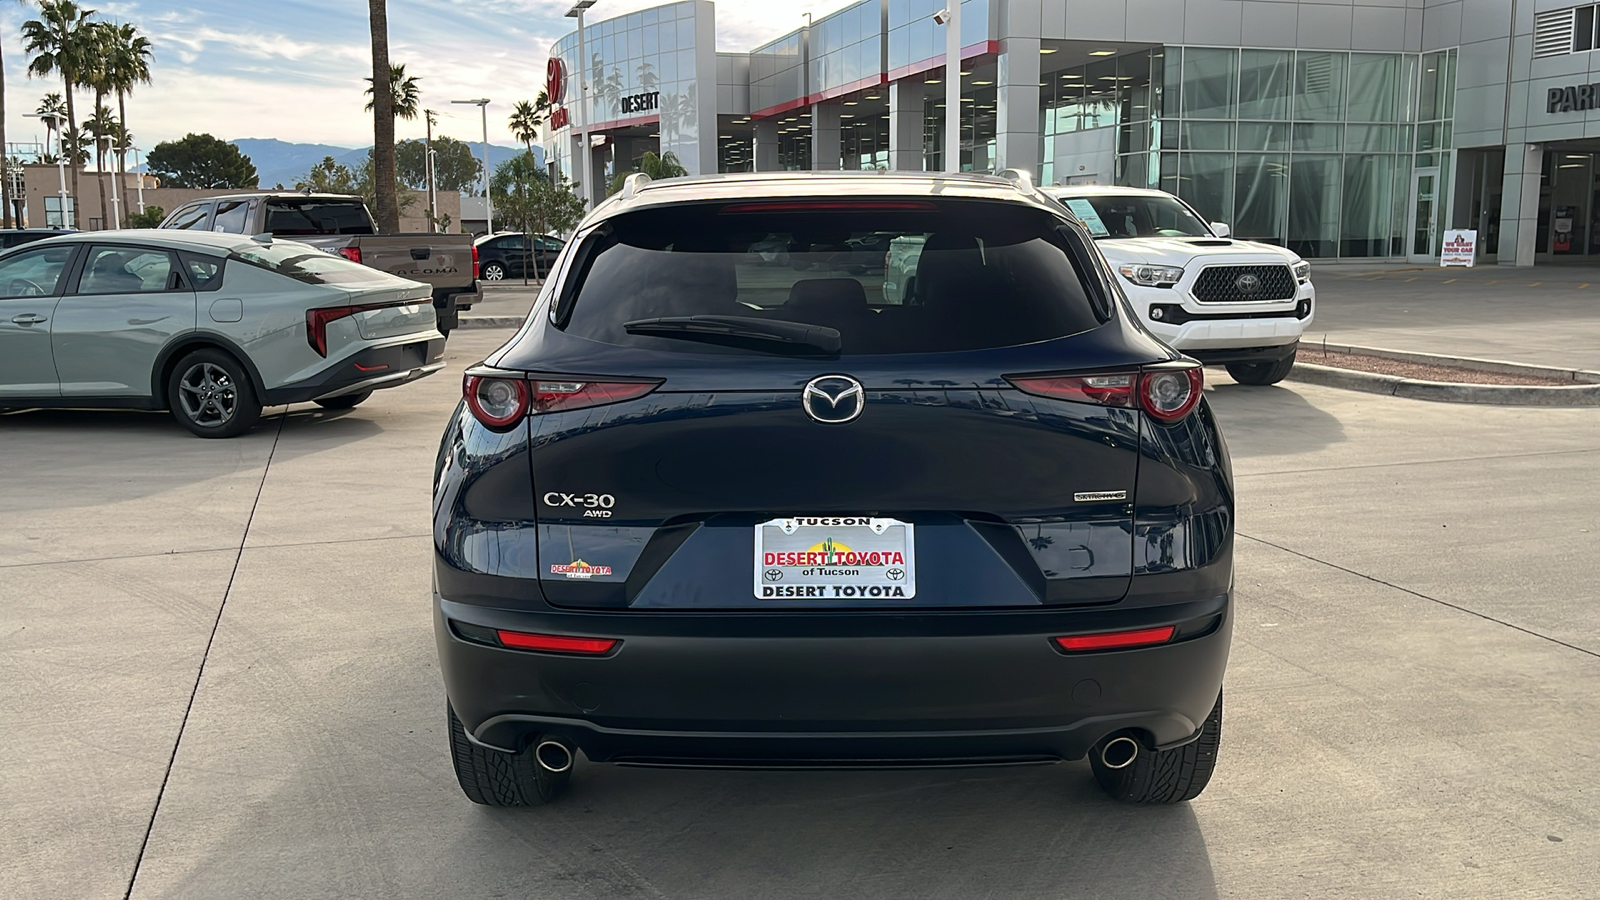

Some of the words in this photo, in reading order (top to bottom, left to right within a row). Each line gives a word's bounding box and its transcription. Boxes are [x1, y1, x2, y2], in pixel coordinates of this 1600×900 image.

[621, 91, 660, 114] DESERT
[543, 491, 616, 509] CX-30
[583, 509, 612, 518] AWD
[795, 518, 871, 526] TUCSON
[764, 552, 828, 566] DESERT
[834, 552, 904, 565] TOYOTA
[551, 565, 578, 573] DESERT
[581, 565, 612, 574] TOYOTA
[803, 567, 815, 576] of
[817, 567, 859, 576] Tucson
[763, 586, 826, 597] DESERT
[833, 586, 905, 597] TOYOTA
